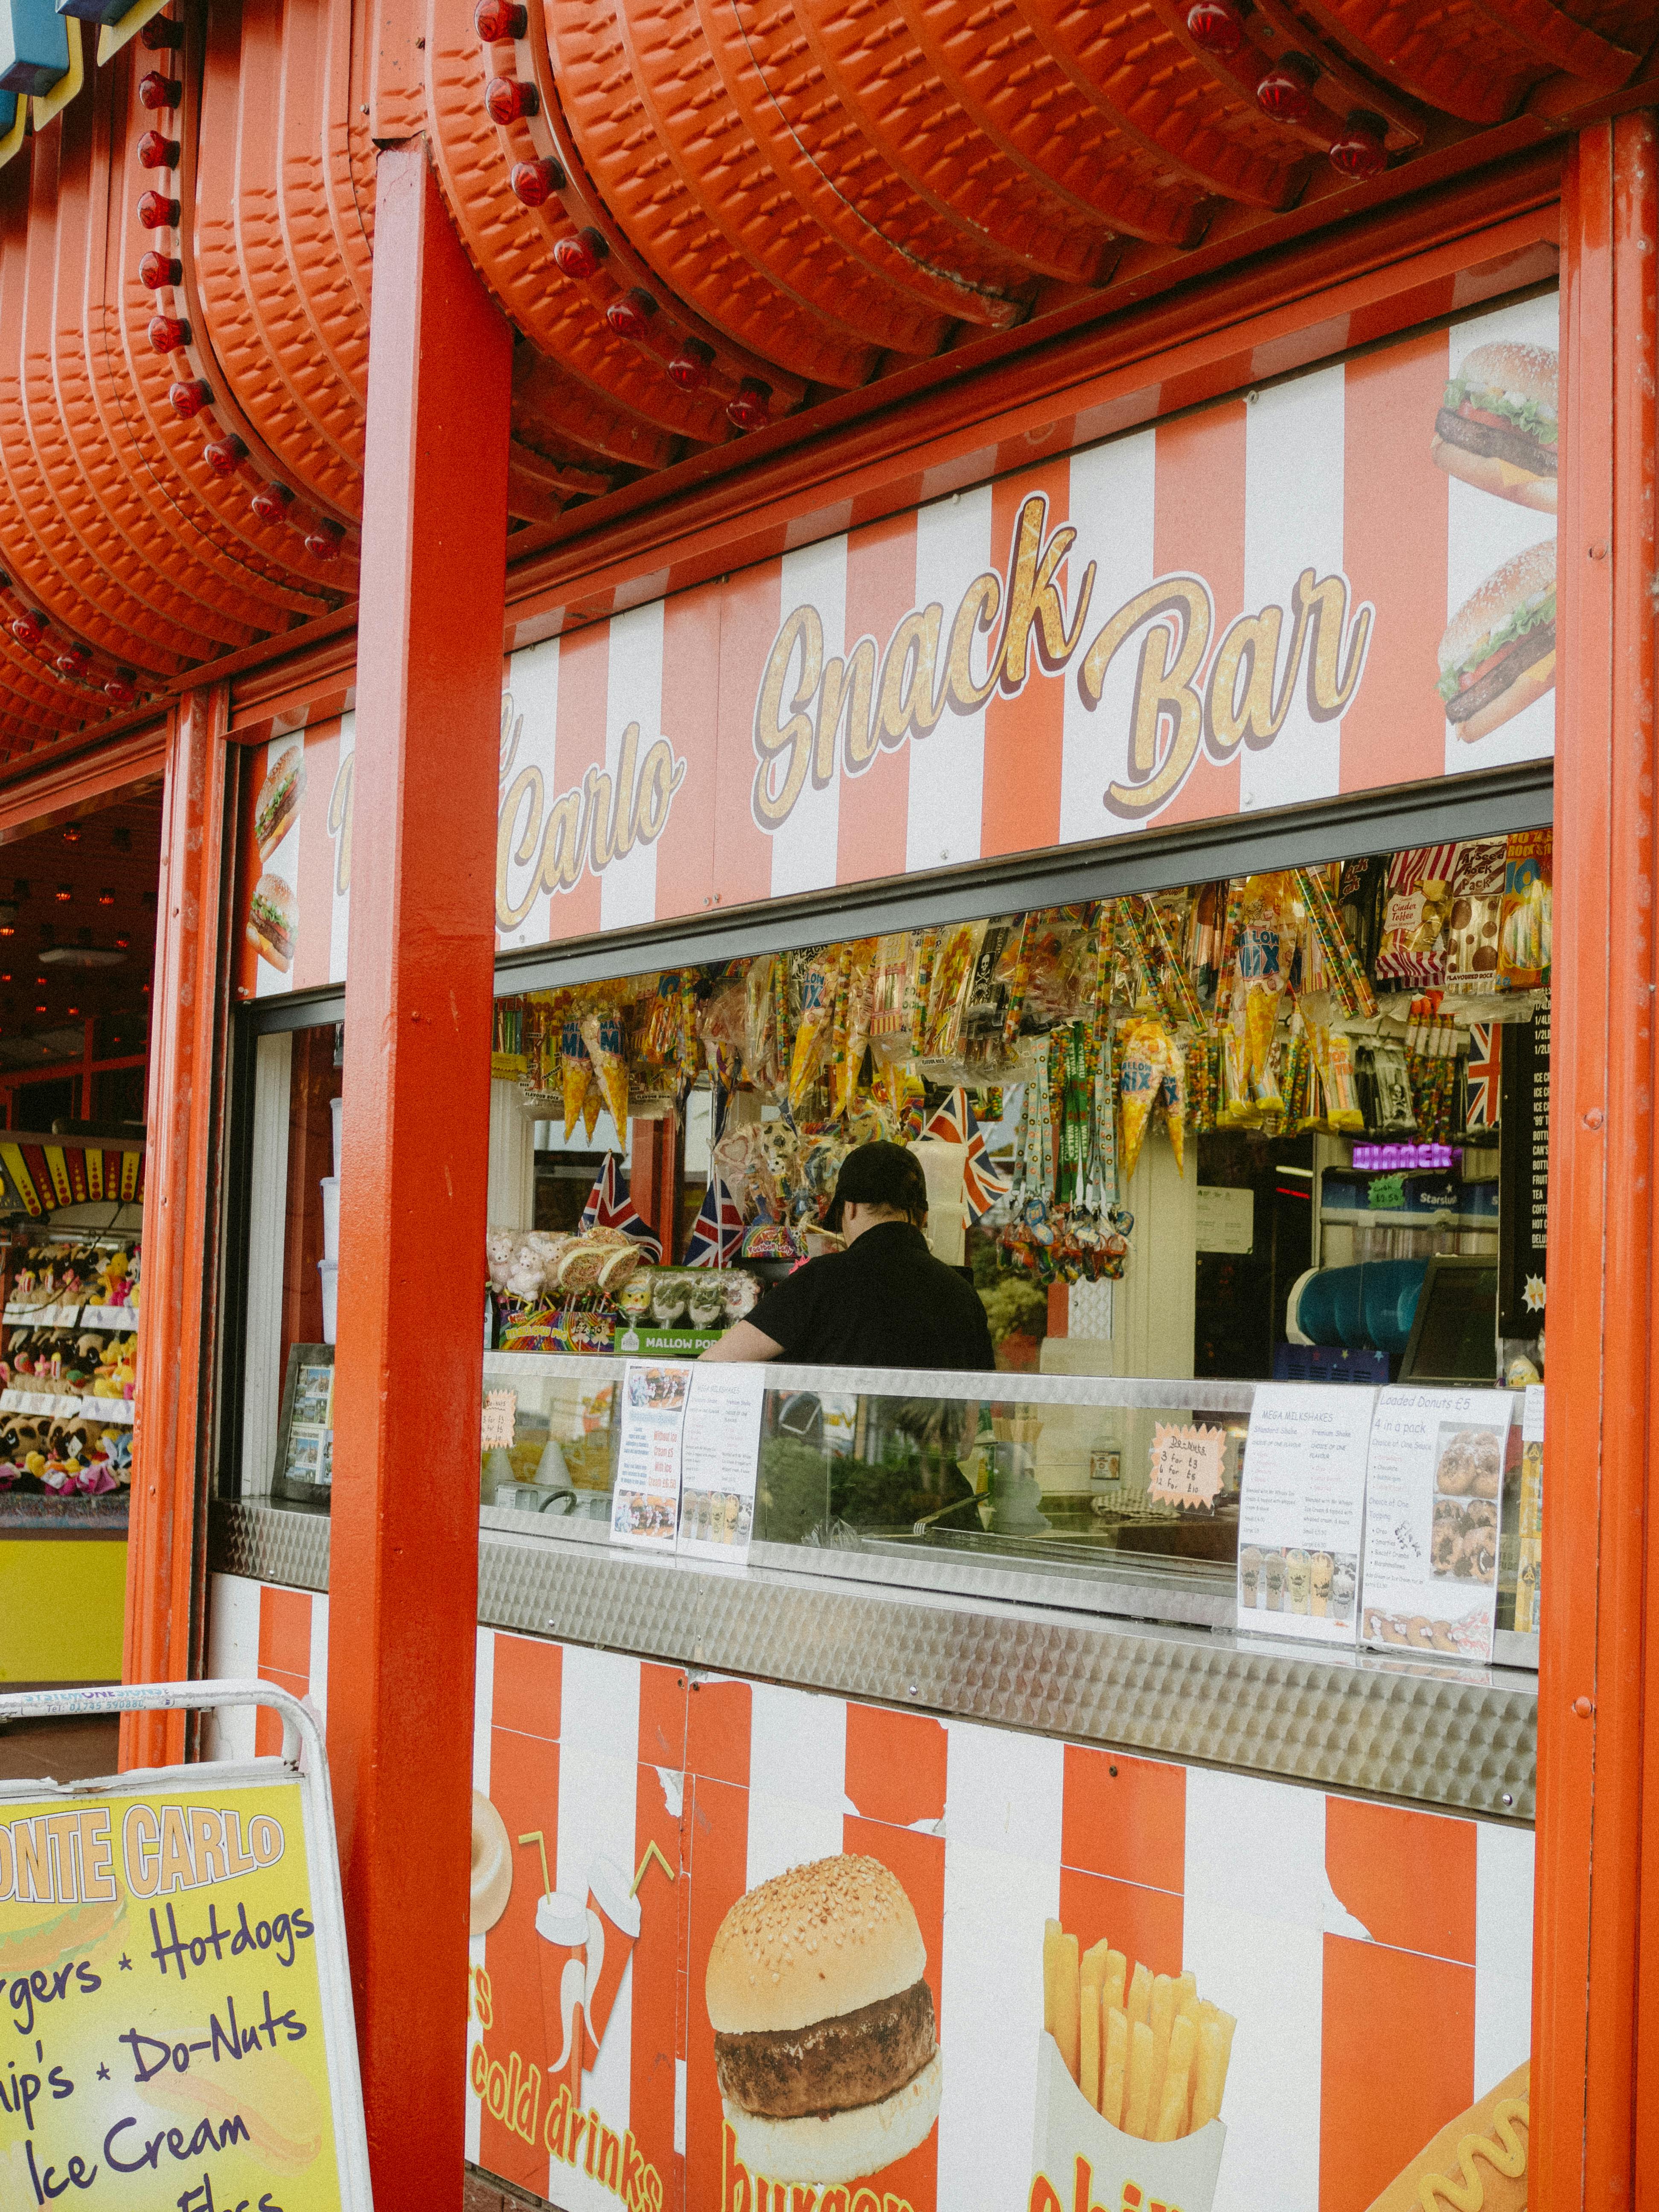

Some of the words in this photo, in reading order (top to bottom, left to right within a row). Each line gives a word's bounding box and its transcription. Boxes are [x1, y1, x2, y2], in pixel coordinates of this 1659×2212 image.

[754, 492, 1097, 830] Snack
[1077, 568, 1371, 820] Bar
[496, 721, 685, 933] Carlo
[1464, 865, 1493, 875] Rock
[1505, 859, 1540, 894] 10
[1462, 879, 1491, 891] Pack
[1392, 902, 1417, 912] Cinder
[1392, 911, 1414, 921] Toffee
[1534, 1073, 1543, 1083] ICE
[1534, 1088, 1543, 1097] ICE
[1534, 1102, 1542, 1112] ICE
[1533, 1131, 1548, 1141] BOTTL
[1533, 1160, 1548, 1170] BOTTL
[1533, 1175, 1548, 1185] FRUIT
[1533, 1190, 1543, 1199] TEA
[1532, 1219, 1543, 1229] HOT
[1532, 1234, 1547, 1244] DELU
[747, 1243, 775, 1254] Football
[777, 1244, 794, 1256] Lolly
[505, 1326, 551, 1339] MALLOW
[551, 1327, 568, 1341] PIG
[646, 1337, 693, 1348] MALLOW
[1380, 1395, 1416, 1406] Loaded
[1418, 1396, 1452, 1409] Donuts
[1455, 1397, 1471, 1410] £5
[1262, 1410, 1282, 1420] MEGA
[1285, 1412, 1333, 1423] MILKSHAKES
[1254, 1426, 1278, 1434] Standard
[1374, 1418, 1381, 1430] 4
[1384, 1421, 1392, 1431] in
[1395, 1424, 1400, 1432] a
[1403, 1421, 1426, 1435] pack
[654, 1430, 669, 1441] Without
[1312, 1429, 1333, 1437] Premium
[1372, 1438, 1391, 1447] Choice
[1415, 1442, 1432, 1450] Sauce
[654, 1446, 667, 1457] Cream
[1161, 1451, 1167, 1461] 3
[1171, 1453, 1182, 1464] for
[655, 1461, 664, 1472] With
[1160, 1464, 1163, 1473] 6
[1169, 1465, 1179, 1475] for
[649, 1476, 661, 1487] Cream
[1167, 1478, 1178, 1489] for
[1369, 1497, 1388, 1506] Choice
[1370, 1511, 1391, 1520] Topping
[1374, 1560, 1405, 1569] Marshmallows
[47, 1704, 65, 1713] Tel:
[122, 1803, 285, 1900] CARLO
[0, 1961, 102, 2034] gers
[150, 1903, 314, 1980] Hotdogs
[119, 1989, 307, 2083] Do-Nuts
[471, 2040, 541, 2145] cold
[544, 2083, 663, 2212] drinks
[26, 2140, 96, 2206] Ice
[103, 2112, 250, 2174] Cream
